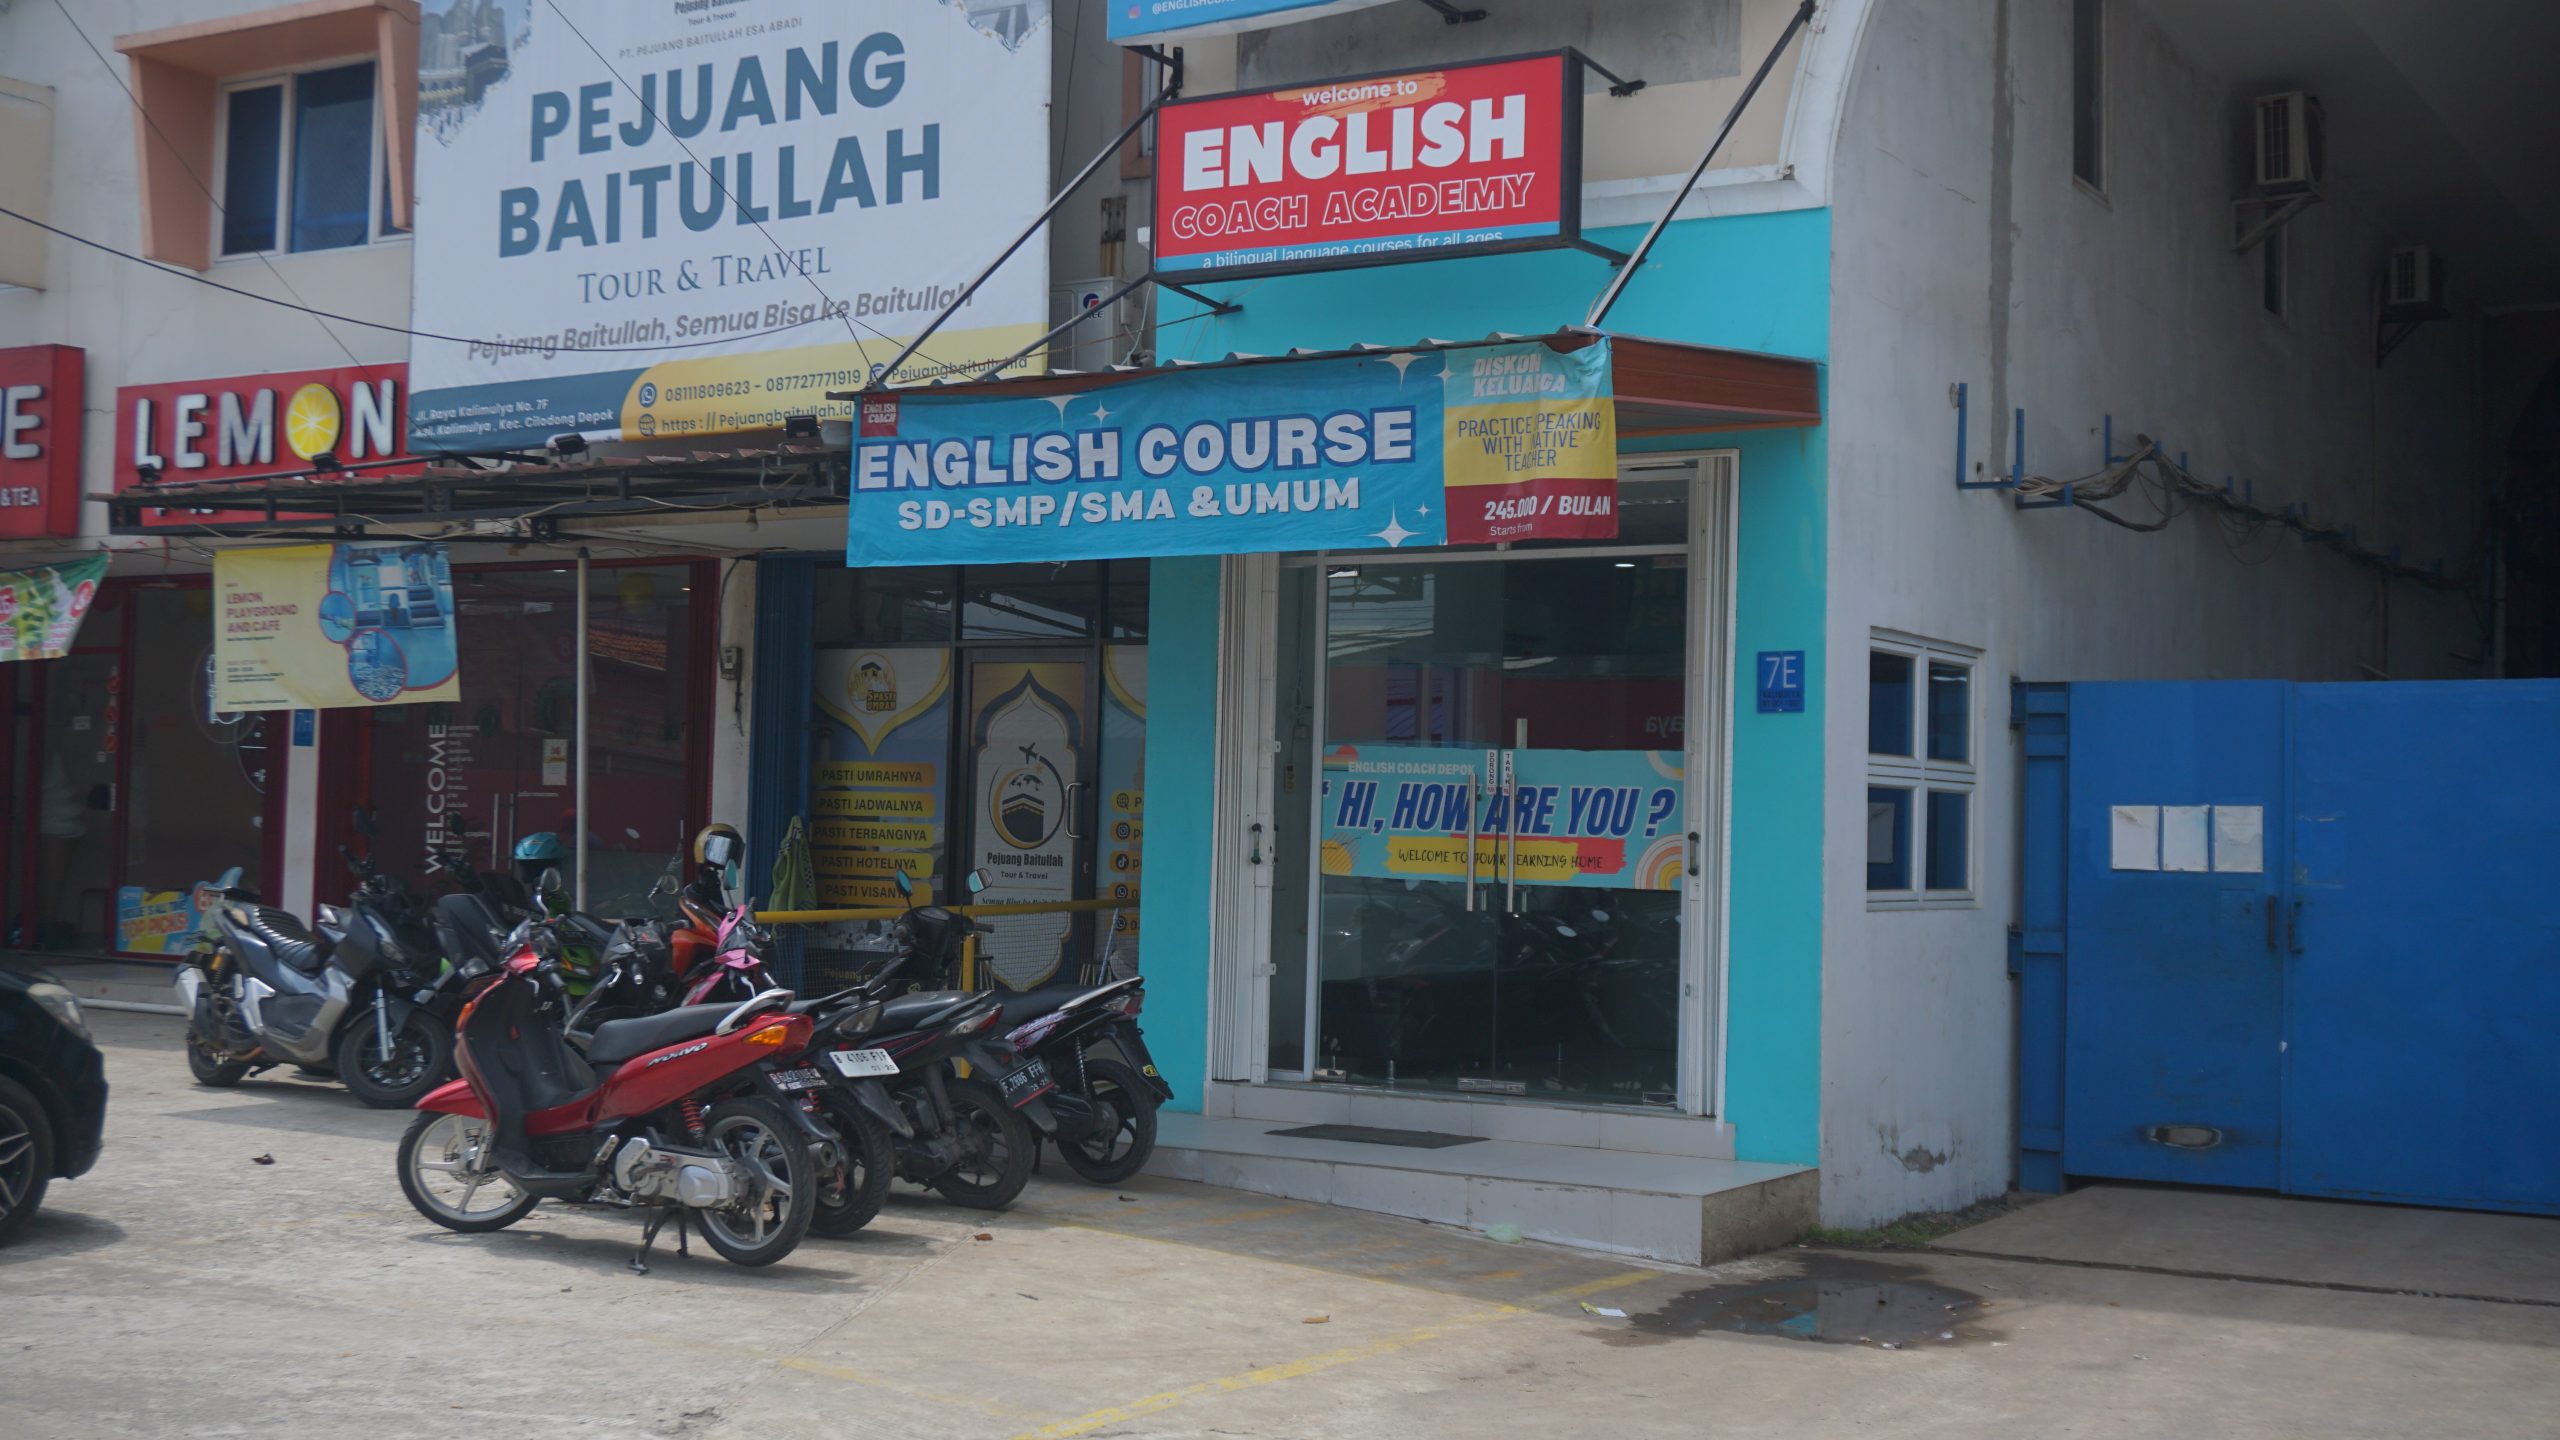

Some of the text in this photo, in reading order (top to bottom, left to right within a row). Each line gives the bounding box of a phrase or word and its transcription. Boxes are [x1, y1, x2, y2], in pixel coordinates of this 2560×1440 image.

[636, 39, 684, 57] PEJUANG
[686, 29, 743, 48] BAITULLAH
[746, 24, 766, 37] ESA
[768, 17, 803, 33] ABADI
[530, 31, 906, 163] PEJUANG
[1303, 79, 1418, 106] welcome to
[1183, 93, 1526, 192] ENGLISH
[499, 122, 941, 259] BAITULLAH
[1171, 172, 1536, 240] COACH ACADEMY
[1202, 257, 1211, 268] a
[1216, 248, 1277, 267] bilingual
[1282, 245, 1350, 261] language
[1353, 239, 1412, 254] courses
[1416, 234, 1439, 248] for
[1443, 232, 1460, 245] all
[677, 258, 703, 291] &
[467, 333, 556, 361] Pejuang
[565, 318, 671, 353] Baitullah,
[676, 309, 758, 338] Semua
[765, 301, 815, 328] Bisa
[822, 296, 848, 322] ke
[1472, 354, 1542, 377] DISKON
[665, 381, 751, 402] 08111809623
[766, 369, 862, 392] 087727771919
[430, 409, 457, 422] Raya
[458, 404, 515, 418] Kalimulya
[516, 401, 534, 412] No.
[536, 399, 550, 410] 7F
[499, 418, 523, 430] Kec.
[525, 415, 576, 428] Cilodong
[577, 408, 615, 423] Depok
[661, 416, 697, 435] https
[1458, 416, 1532, 438] PRACTICE
[857, 405, 1416, 493] ENGLISH COURSE
[1482, 436, 1523, 455] WITH
[12, 487, 40, 506] TEA
[1558, 495, 1611, 516] BULAN
[898, 487, 1176, 530] SD-SMP/SMA
[1490, 524, 1517, 536] Starts
[226, 592, 263, 604] LEMON
[226, 604, 298, 619] PLAYGROUND
[226, 619, 281, 633] AND CAFE
[1765, 656, 1797, 689] 7E
[822, 769, 923, 783] PASTI UMRAHNYA
[1348, 761, 1475, 776] ENGLISH COACH DEPOK
[425, 724, 447, 874] WELCOME
[820, 798, 923, 812] PASTI JADWALNYA
[1336, 780, 1677, 837] HI, HOW ARE YOU ?
[815, 826, 927, 842] PASTI TERBANGNYA
[822, 855, 918, 871] PASTI HOTELNYA
[987, 852, 1064, 867] Pejuang Baitullah
[1398, 850, 1449, 864] WELCOME
[1571, 856, 1603, 869] HOME
[1001, 871, 1017, 879] Tour
[1025, 871, 1048, 880] Travel
[825, 884, 858, 897] PASTI
